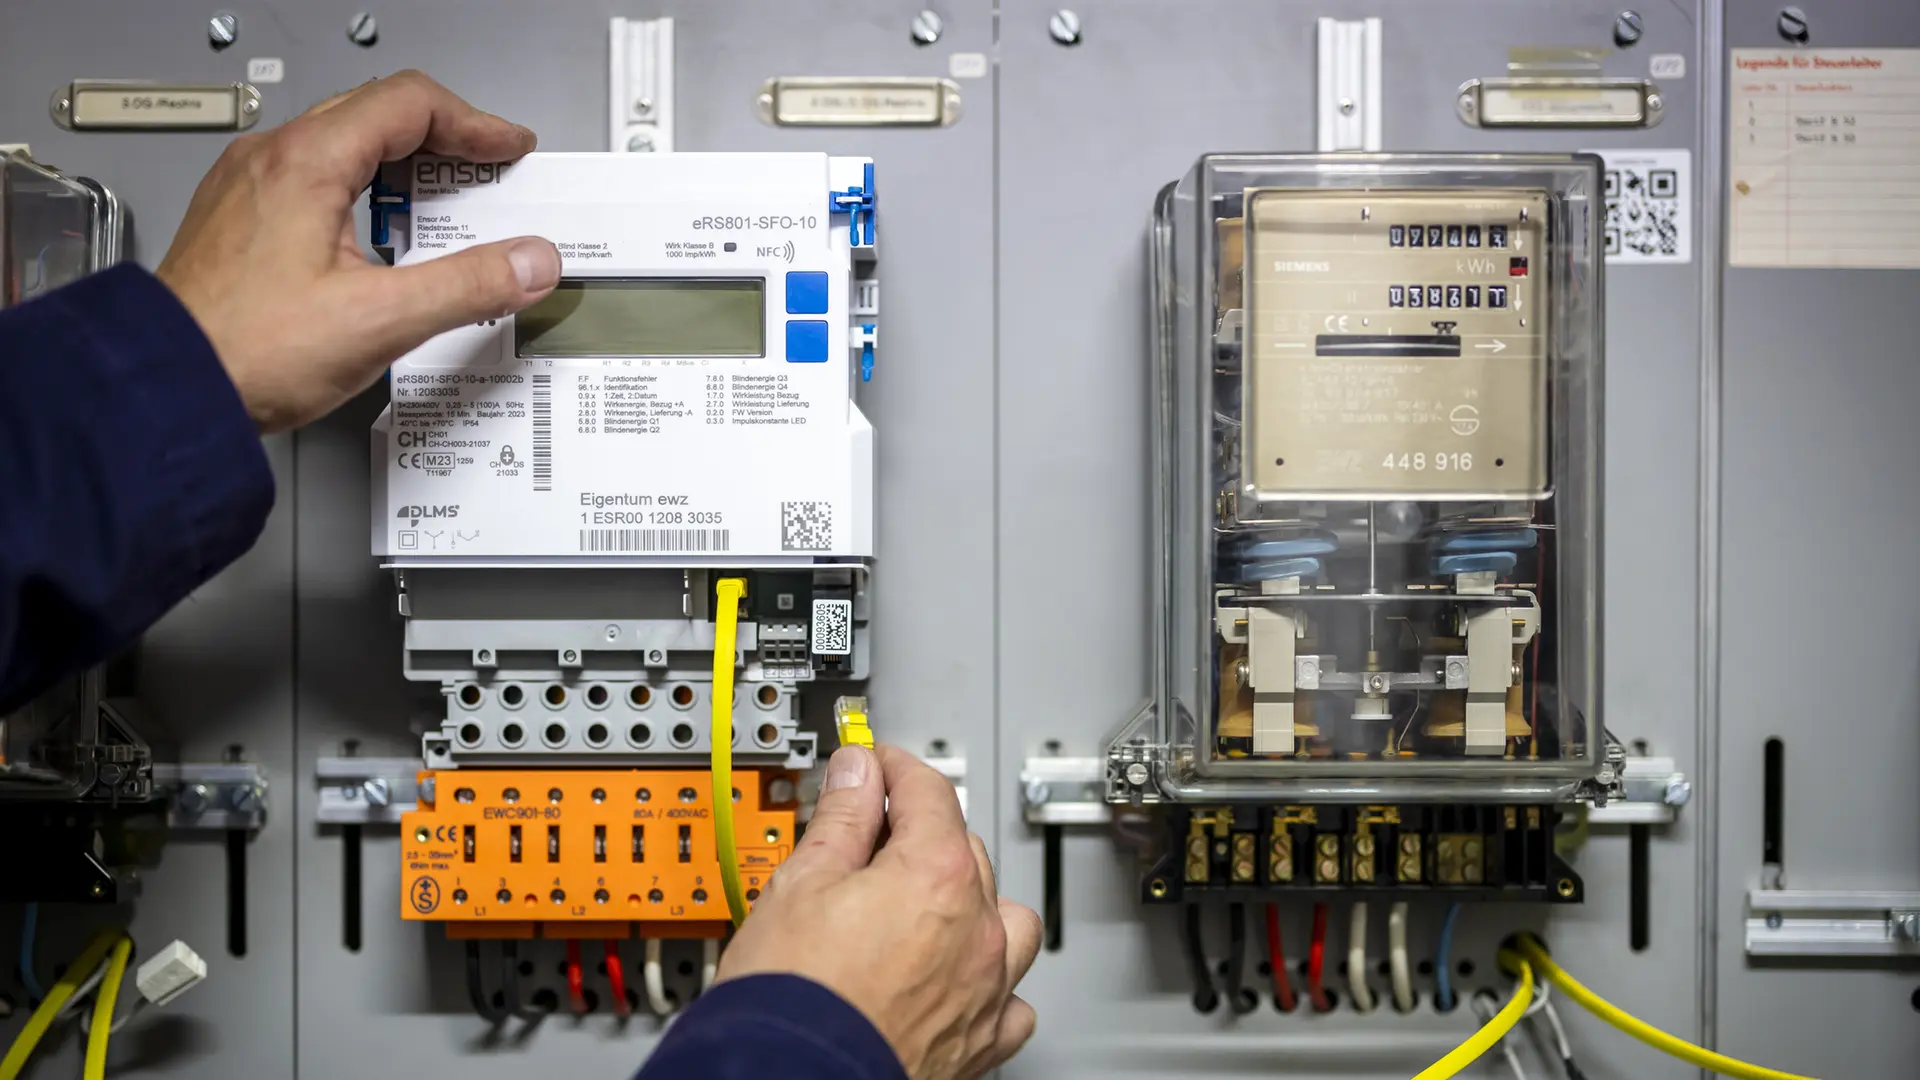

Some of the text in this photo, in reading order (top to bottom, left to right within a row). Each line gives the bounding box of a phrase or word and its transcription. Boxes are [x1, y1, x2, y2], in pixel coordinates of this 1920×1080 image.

[417, 162, 511, 184] ensor
[692, 216, 816, 230] eRS801-SFO-10
[757, 247, 781, 257] NFC
[1274, 261, 1330, 272] SIEMENS
[1456, 259, 1495, 274] kWh
[1324, 314, 1348, 333] CE
[397, 375, 524, 384] eRS801-SFO-10-a-10002b
[397, 431, 427, 448] CH
[426, 456, 451, 466] M23
[1383, 452, 1426, 471] 448
[1435, 452, 1472, 471] 916
[580, 492, 688, 509] Eigentum ewz
[581, 512, 722, 524] 1 ESR00 1208 3035
[816, 604, 826, 650] 00093605
[483, 807, 561, 819] EWC901-80
[500, 877, 506, 887] 3
[554, 877, 560, 886] 4
[652, 876, 659, 885] 7
[749, 877, 760, 885] 10
[474, 906, 684, 916] L1 L2 L3
